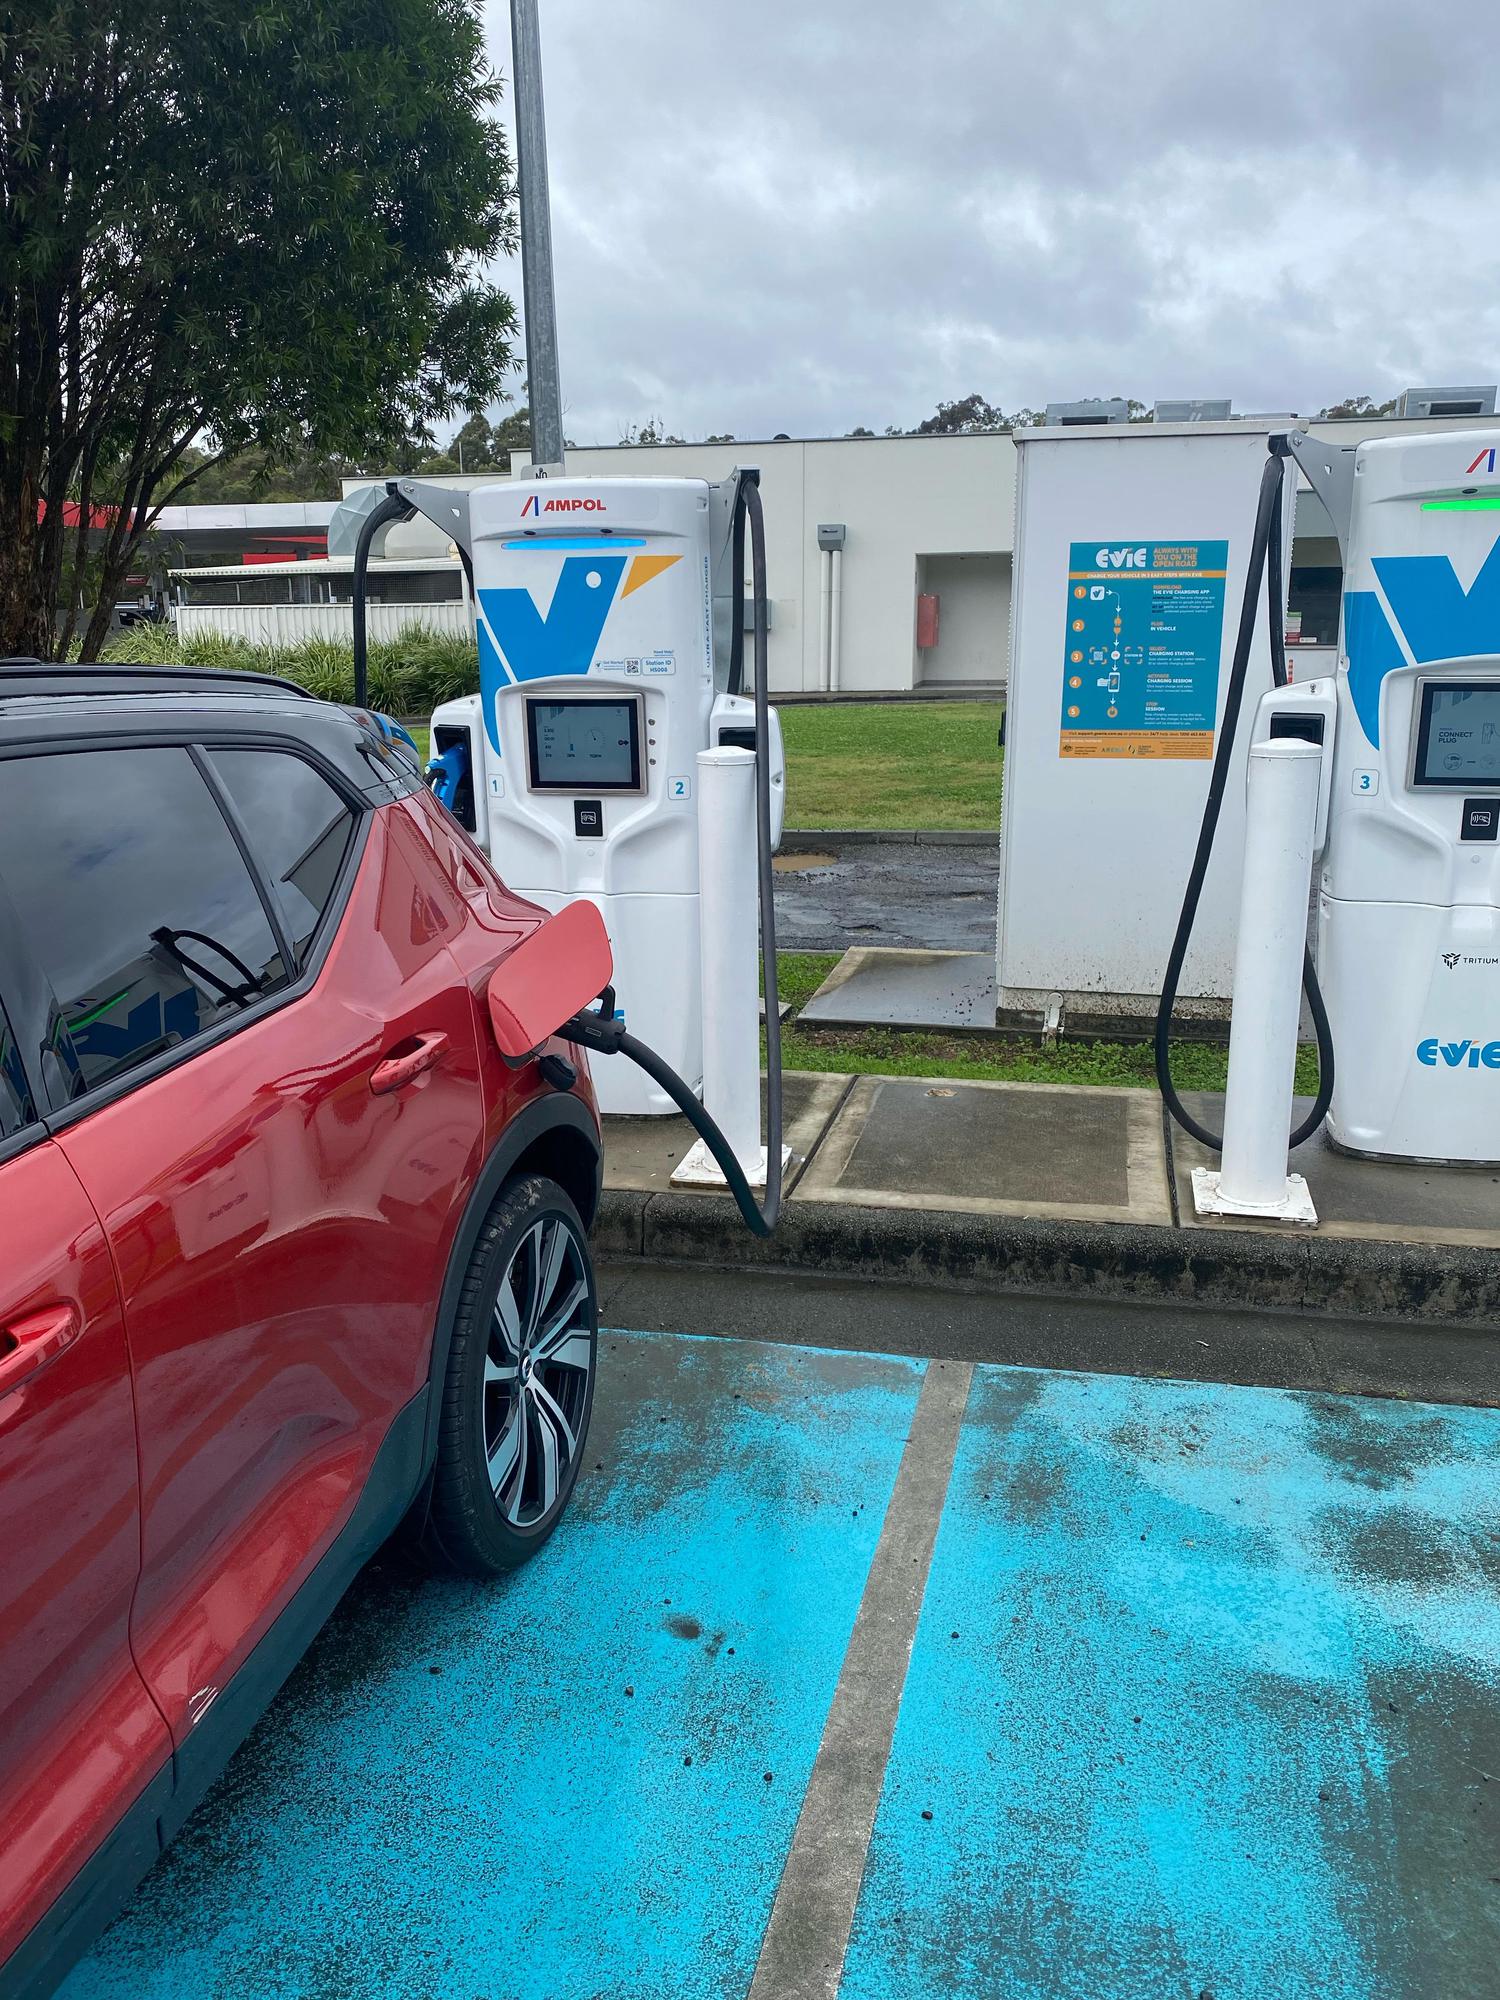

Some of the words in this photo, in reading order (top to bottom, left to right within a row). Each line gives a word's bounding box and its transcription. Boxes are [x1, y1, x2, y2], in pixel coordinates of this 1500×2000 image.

[543, 498, 607, 512] AMPOL
[1096, 548, 1147, 568] EVIE
[491, 779, 498, 793] 1
[674, 782, 685, 795] 2
[1359, 774, 1371, 790] 3
